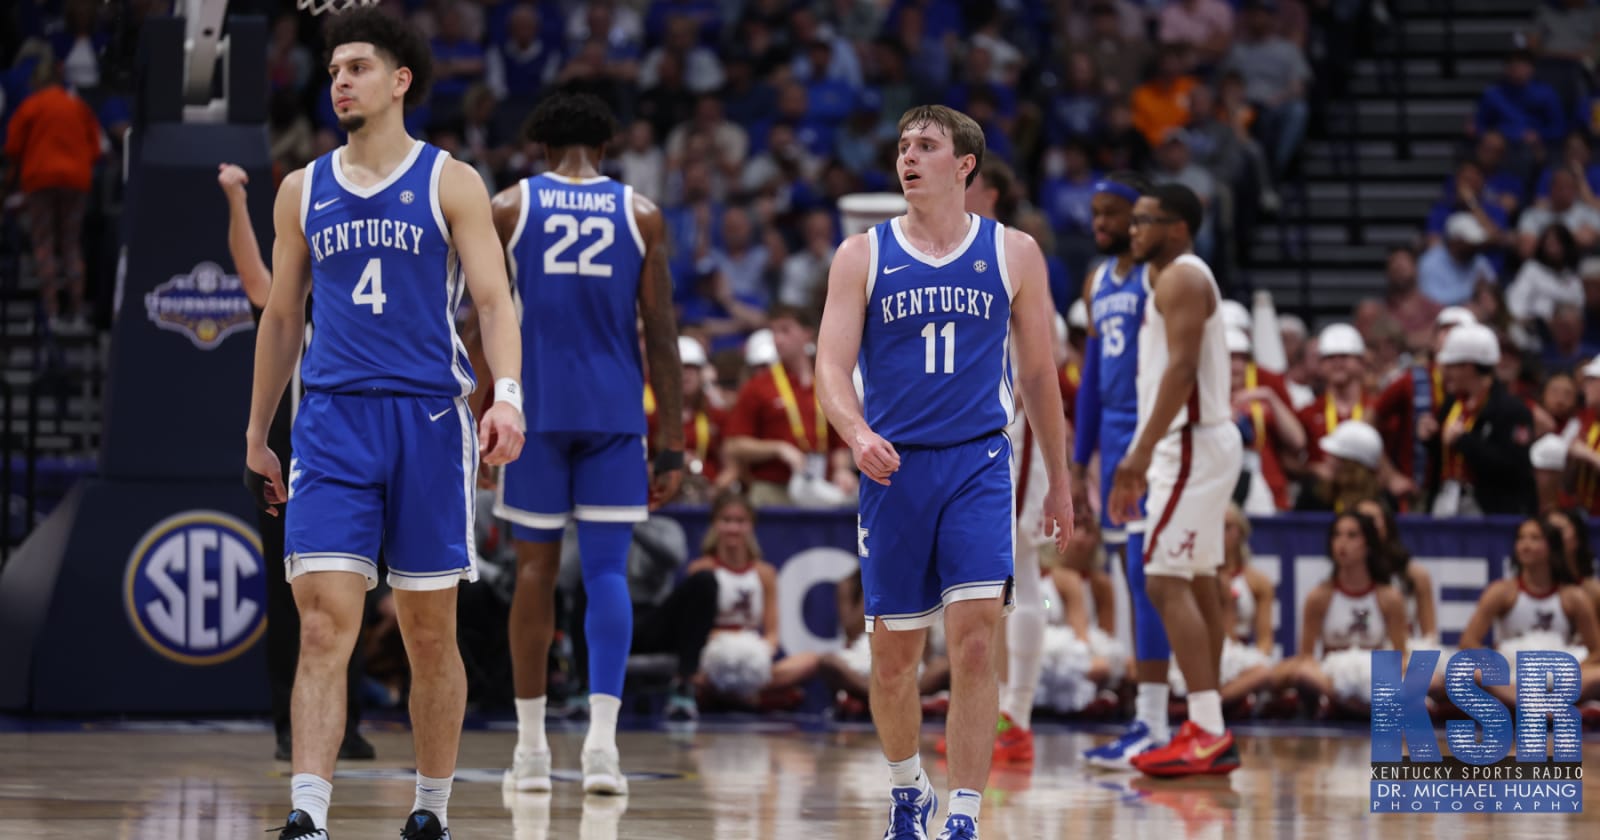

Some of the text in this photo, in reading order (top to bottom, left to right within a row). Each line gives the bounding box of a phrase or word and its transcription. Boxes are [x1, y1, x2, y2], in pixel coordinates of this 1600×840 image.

[538, 188, 616, 213] WILLIAMS
[311, 218, 424, 263] KENTUCKY
[543, 213, 615, 277] 22
[351, 257, 387, 315] 4
[881, 286, 994, 324] KENTUCKY
[921, 321, 955, 374] 11
[1100, 315, 1125, 359] 15
[144, 528, 259, 649] SEC
